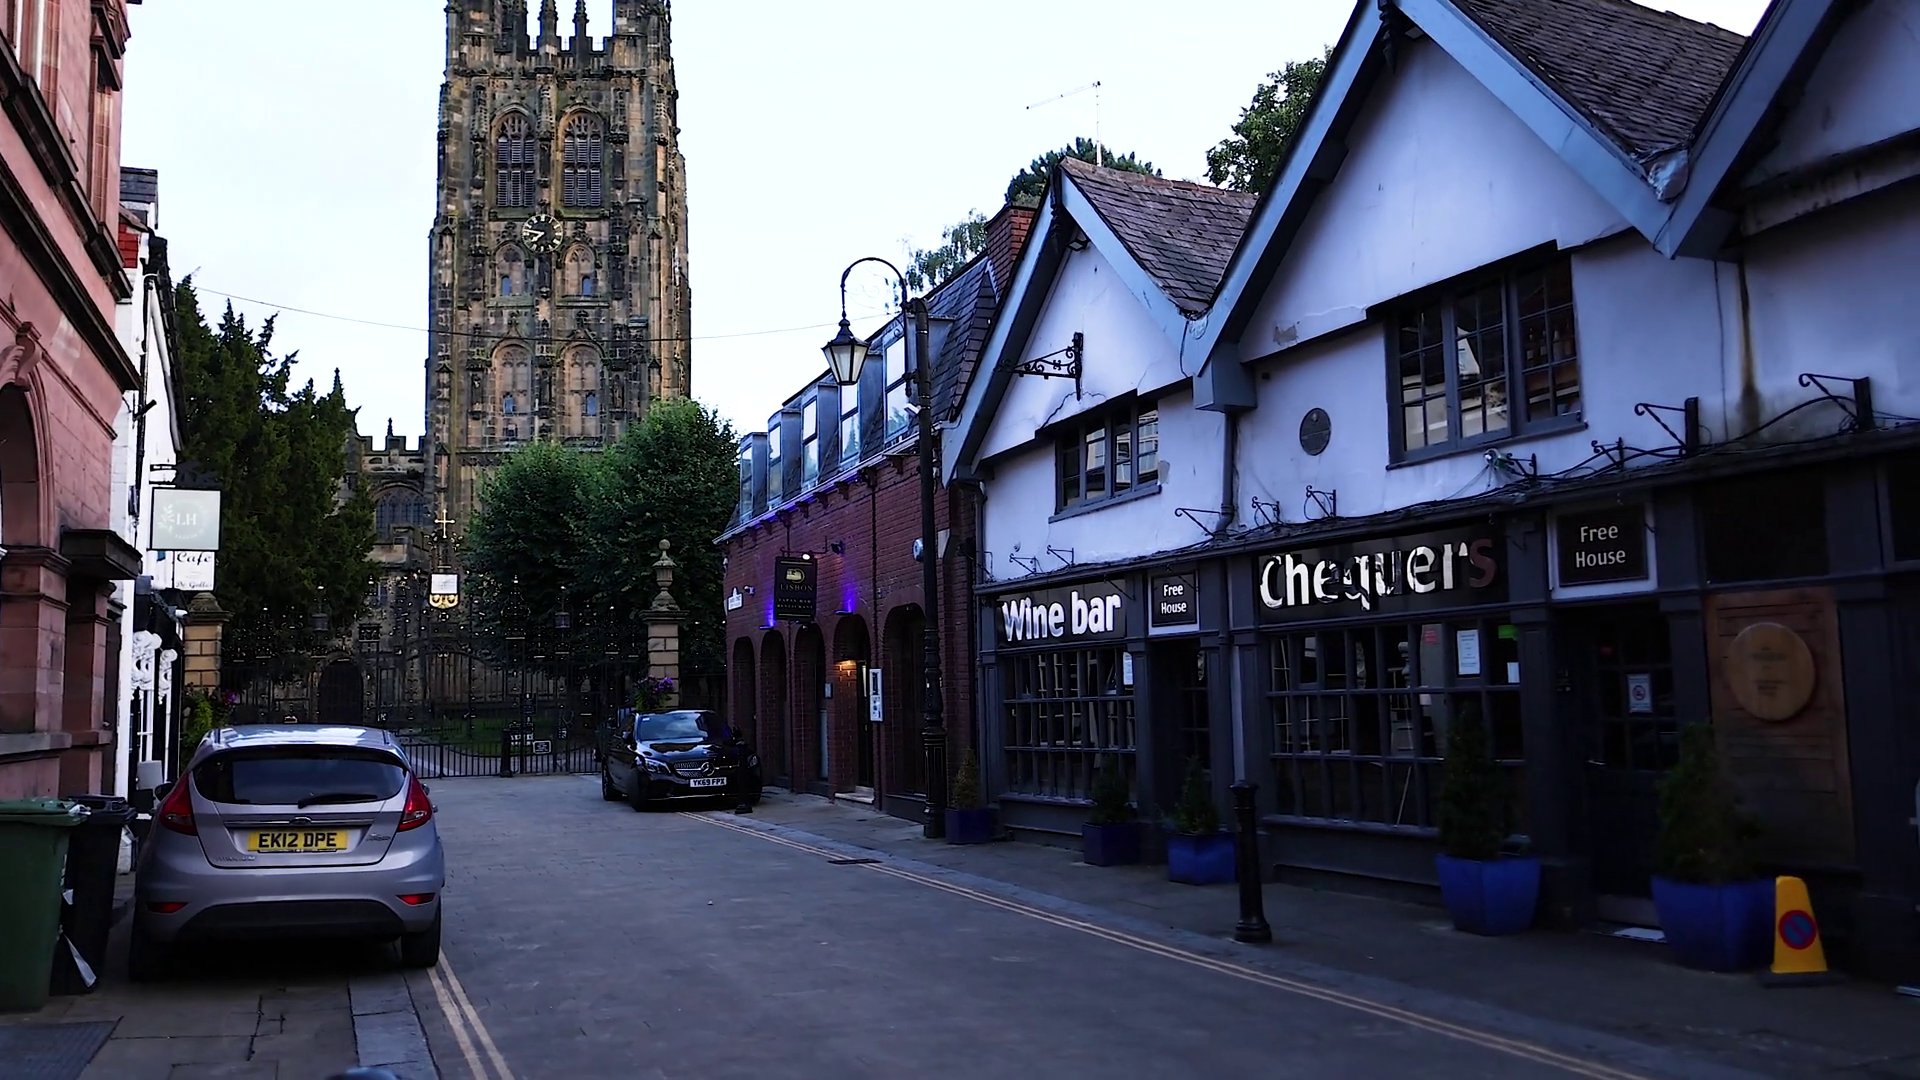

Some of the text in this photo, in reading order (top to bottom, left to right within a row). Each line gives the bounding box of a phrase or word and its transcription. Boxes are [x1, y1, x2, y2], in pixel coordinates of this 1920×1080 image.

[176, 513, 197, 525] LH
[1580, 525, 1619, 543] Free
[1575, 550, 1627, 568] House
[1260, 538, 1497, 611] Chequers
[1163, 584, 1184, 597] Free
[1002, 590, 1122, 642] Wine bar
[1161, 602, 1187, 615] House
[258, 832, 337, 848] EK12 DPE
